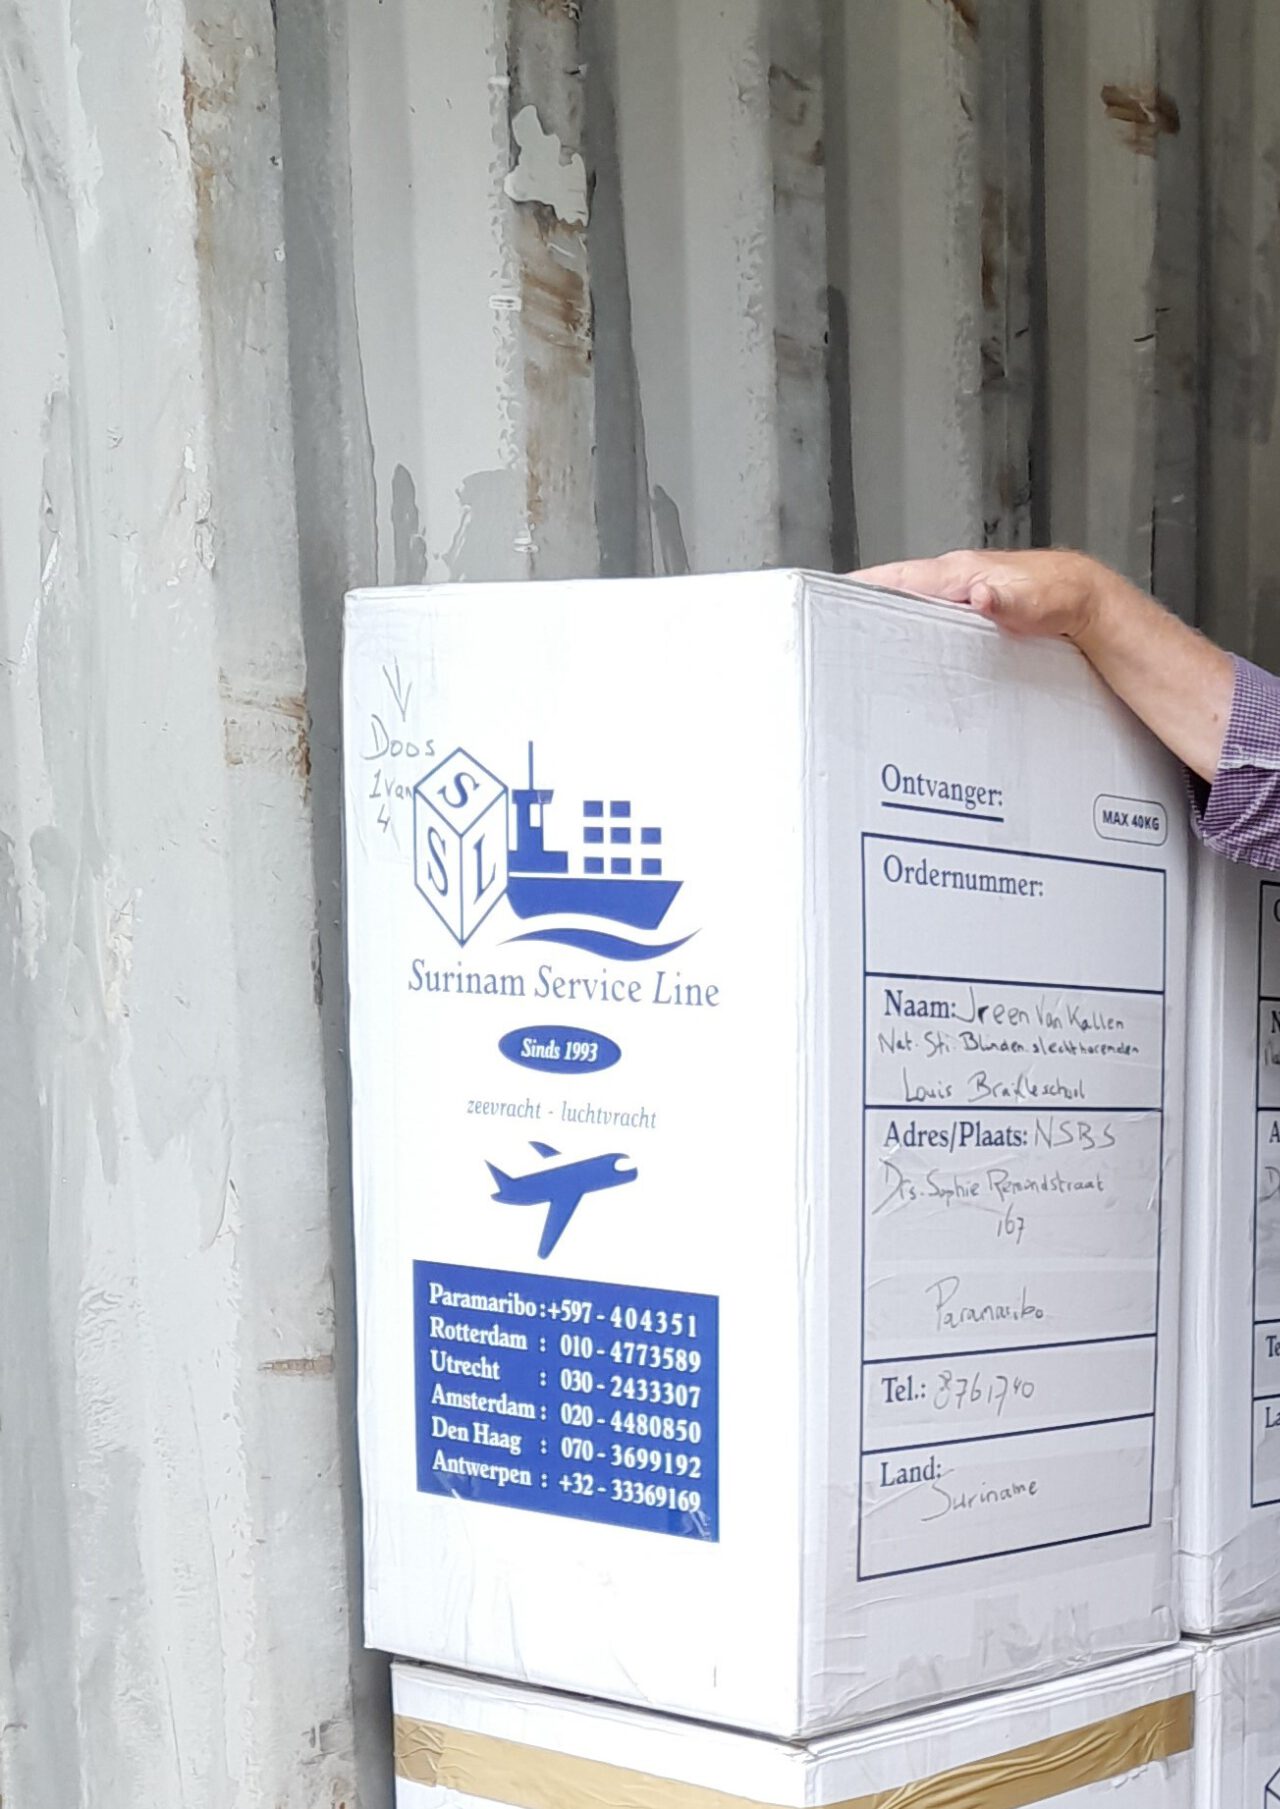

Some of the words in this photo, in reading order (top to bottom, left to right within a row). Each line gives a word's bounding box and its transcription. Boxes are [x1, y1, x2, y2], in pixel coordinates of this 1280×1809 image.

[359, 713, 435, 760] Doos
[881, 763, 1003, 811] Ontvanger:
[376, 803, 391, 833] 4
[1101, 809, 1129, 828] MAX
[1131, 813, 1160, 832] 40KG
[883, 853, 1044, 897] Ordernummer:
[408, 958, 526, 997] Surinam
[534, 964, 642, 1003] Service
[652, 972, 720, 1008] Line
[884, 988, 956, 1019] Naam:
[521, 1037, 561, 1061] Sinds
[563, 1041, 599, 1062] 1993
[466, 1098, 542, 1121] zeevracht
[561, 1101, 657, 1130] luchtvracht
[883, 1121, 1028, 1153] Adres/Plaats:
[1035, 1116, 1116, 1150] NSBS
[429, 1282, 537, 1317] Paramaribo
[429, 1316, 528, 1350] Rotterdam
[430, 1350, 500, 1380] Utrecht
[431, 1383, 536, 1420] Amsterdam
[431, 1415, 469, 1442] Den
[472, 1422, 522, 1455] Haag
[432, 1449, 532, 1487] Antwerpen
[879, 1456, 942, 1488] Land:
[920, 1468, 1038, 1522] Suriname
